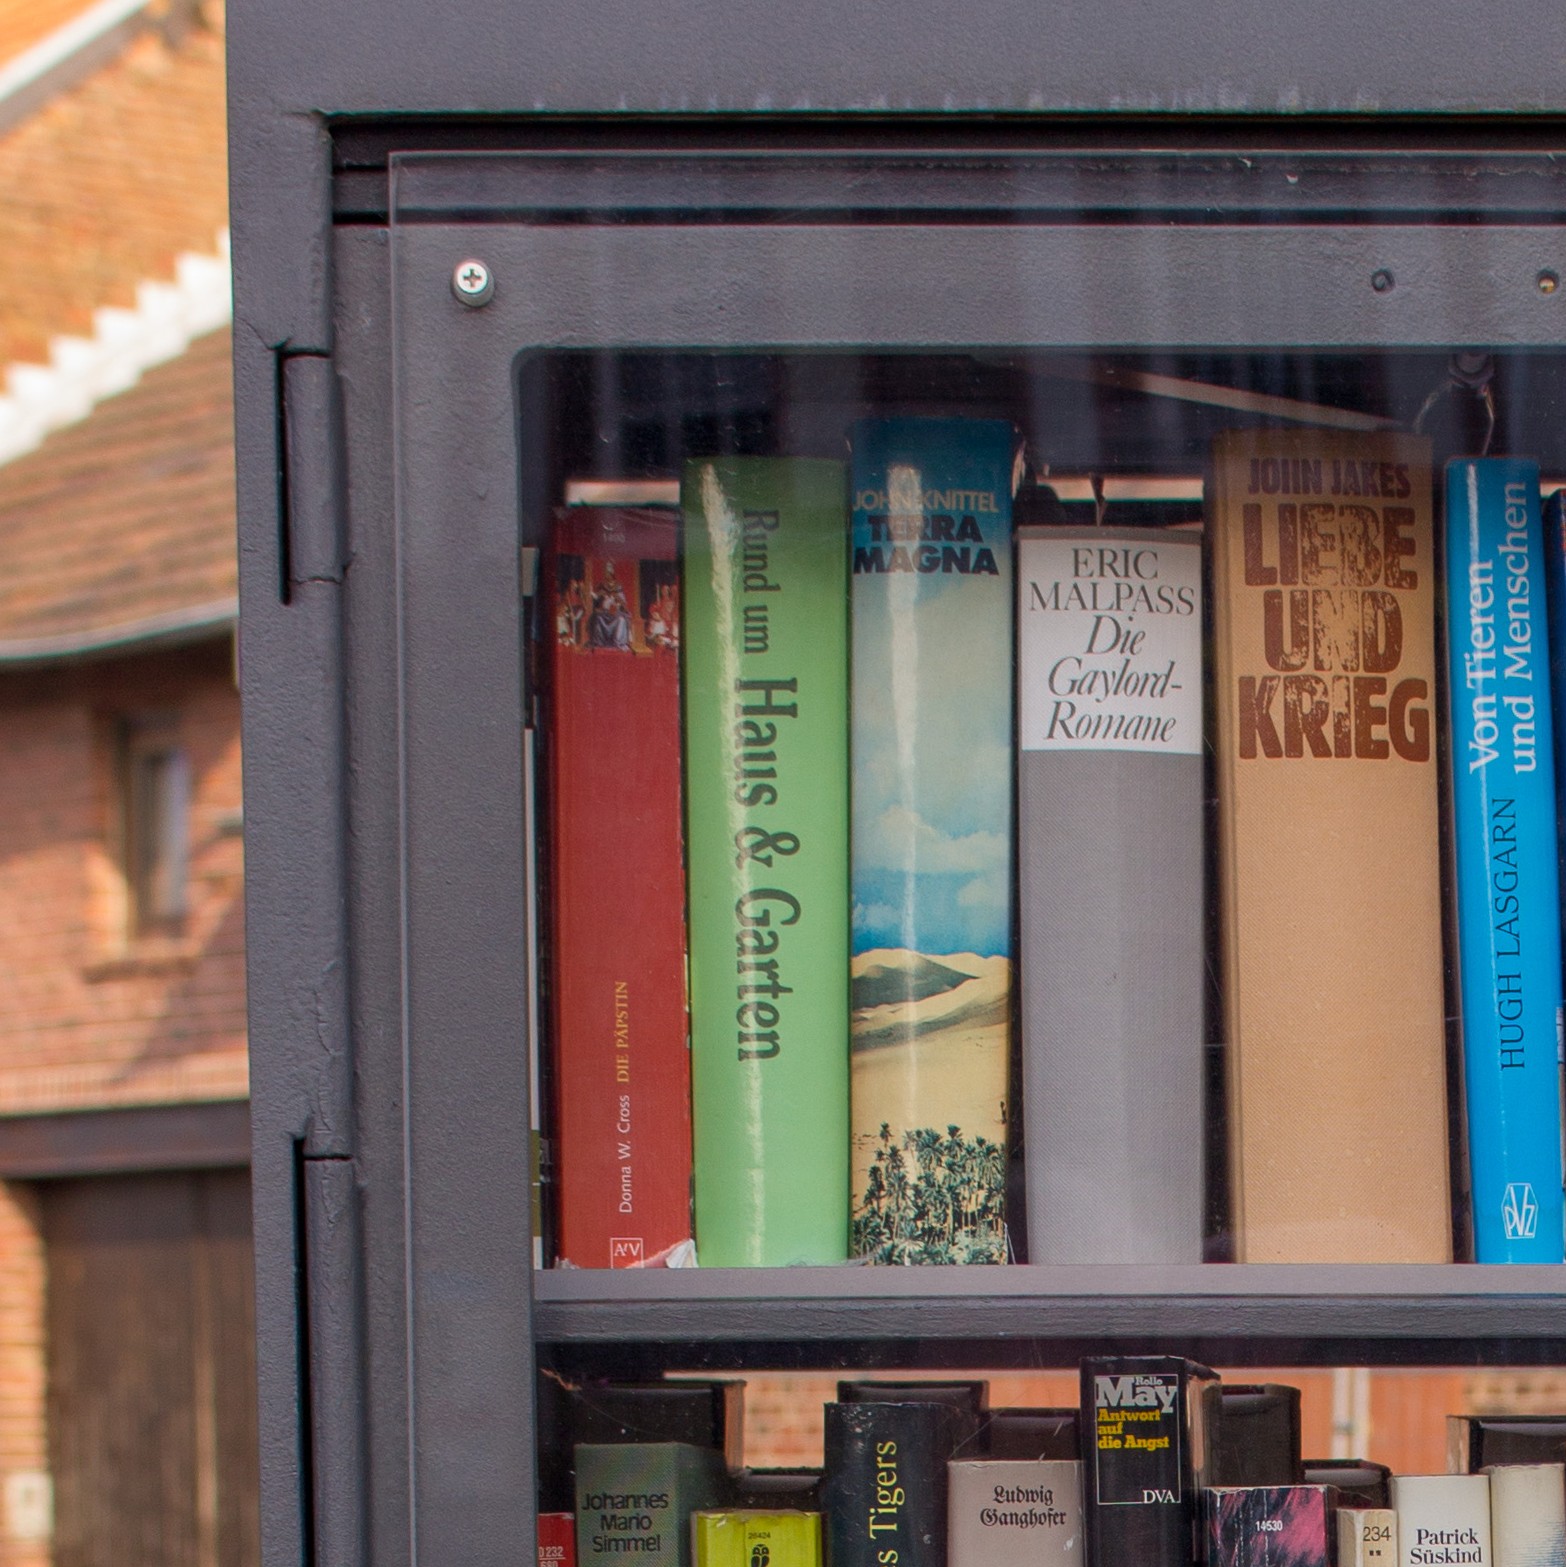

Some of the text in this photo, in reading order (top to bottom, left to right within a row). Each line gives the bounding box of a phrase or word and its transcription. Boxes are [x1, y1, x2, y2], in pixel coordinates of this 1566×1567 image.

[1072, 548, 1158, 579] ERIC
[1243, 502, 1418, 590] LIEBE
[1029, 580, 1195, 616] MALPASS
[1084, 614, 1146, 656] Die
[1263, 588, 1404, 674] UND
[1048, 656, 1183, 703] Gaylord-
[1043, 700, 1178, 743] Romane
[1239, 675, 1431, 763] KRIEG
[734, 509, 801, 1062] Rund um Haus Garten
[1493, 798, 1524, 1069] HUGH LASGARN
[617, 1095, 632, 1213] Donna Cross
[1096, 1377, 1178, 1413] May
[1098, 1408, 1161, 1423] Antwort
[1098, 1422, 1123, 1436] auf
[1098, 1436, 1169, 1451] die Angst
[869, 1441, 905, 1540] Tigers
[993, 1486, 1054, 1506] Ludwig
[1143, 1490, 1175, 1504] DVA
[980, 1508, 1067, 1529] Ganghofer
[1255, 1520, 1283, 1532] 14530
[1410, 1547, 1482, 1564] Süskind
[1416, 1529, 1479, 1546] Patrick
